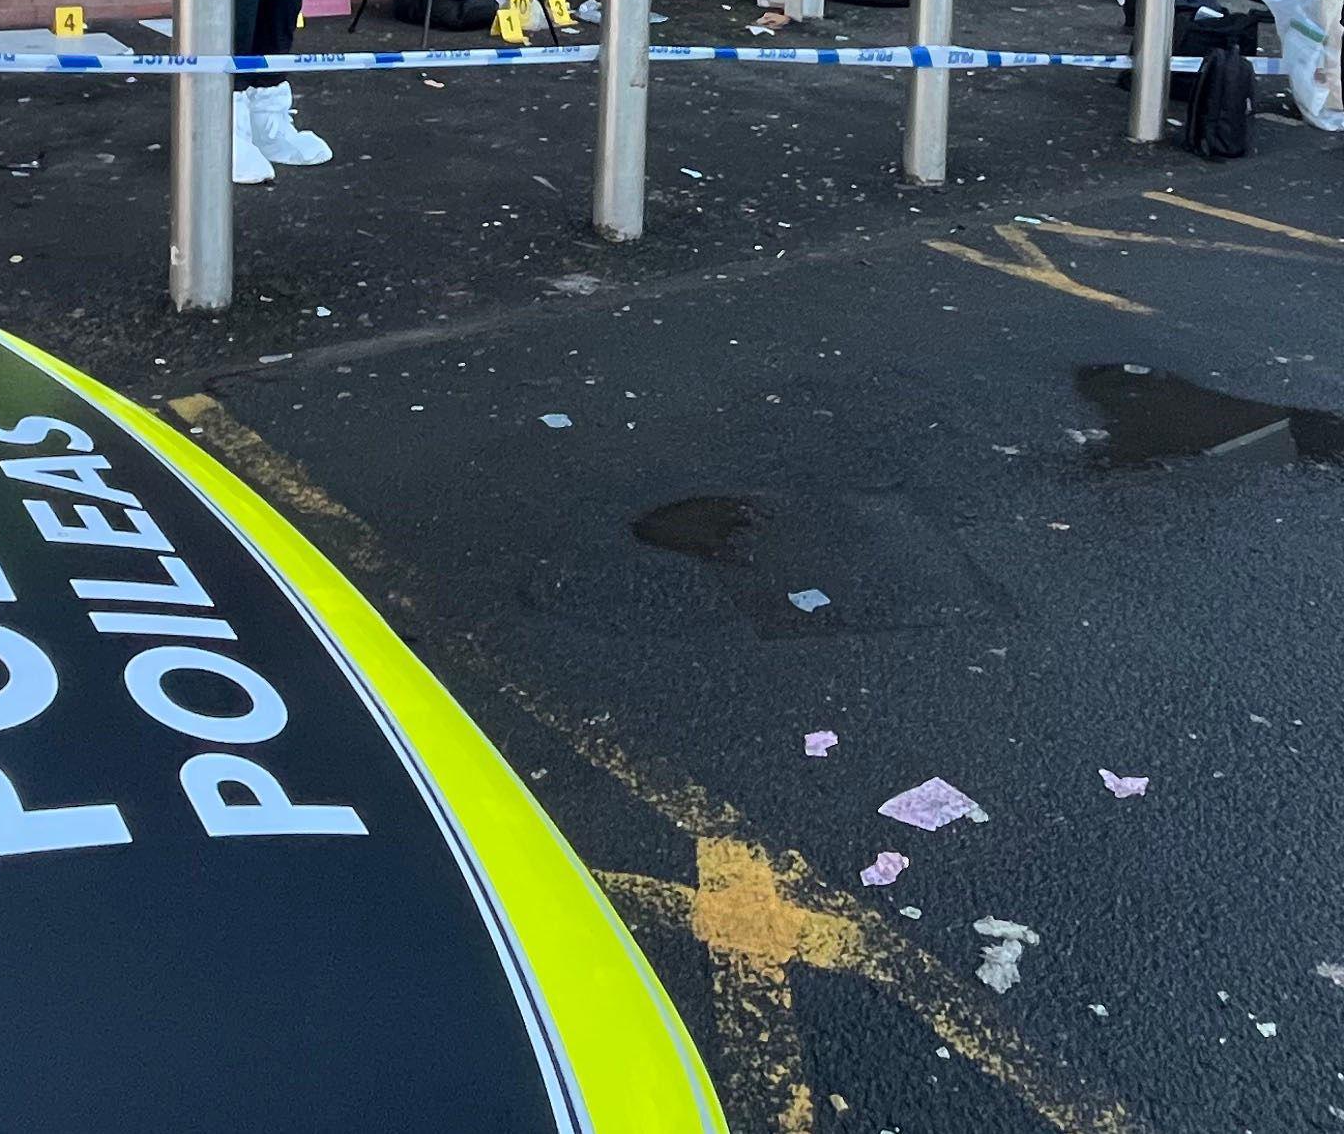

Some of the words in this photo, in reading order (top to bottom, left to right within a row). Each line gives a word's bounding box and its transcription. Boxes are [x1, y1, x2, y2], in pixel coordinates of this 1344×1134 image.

[554, 0, 564, 17] 3
[63, 13, 76, 32] 4
[506, 16, 514, 32] 1
